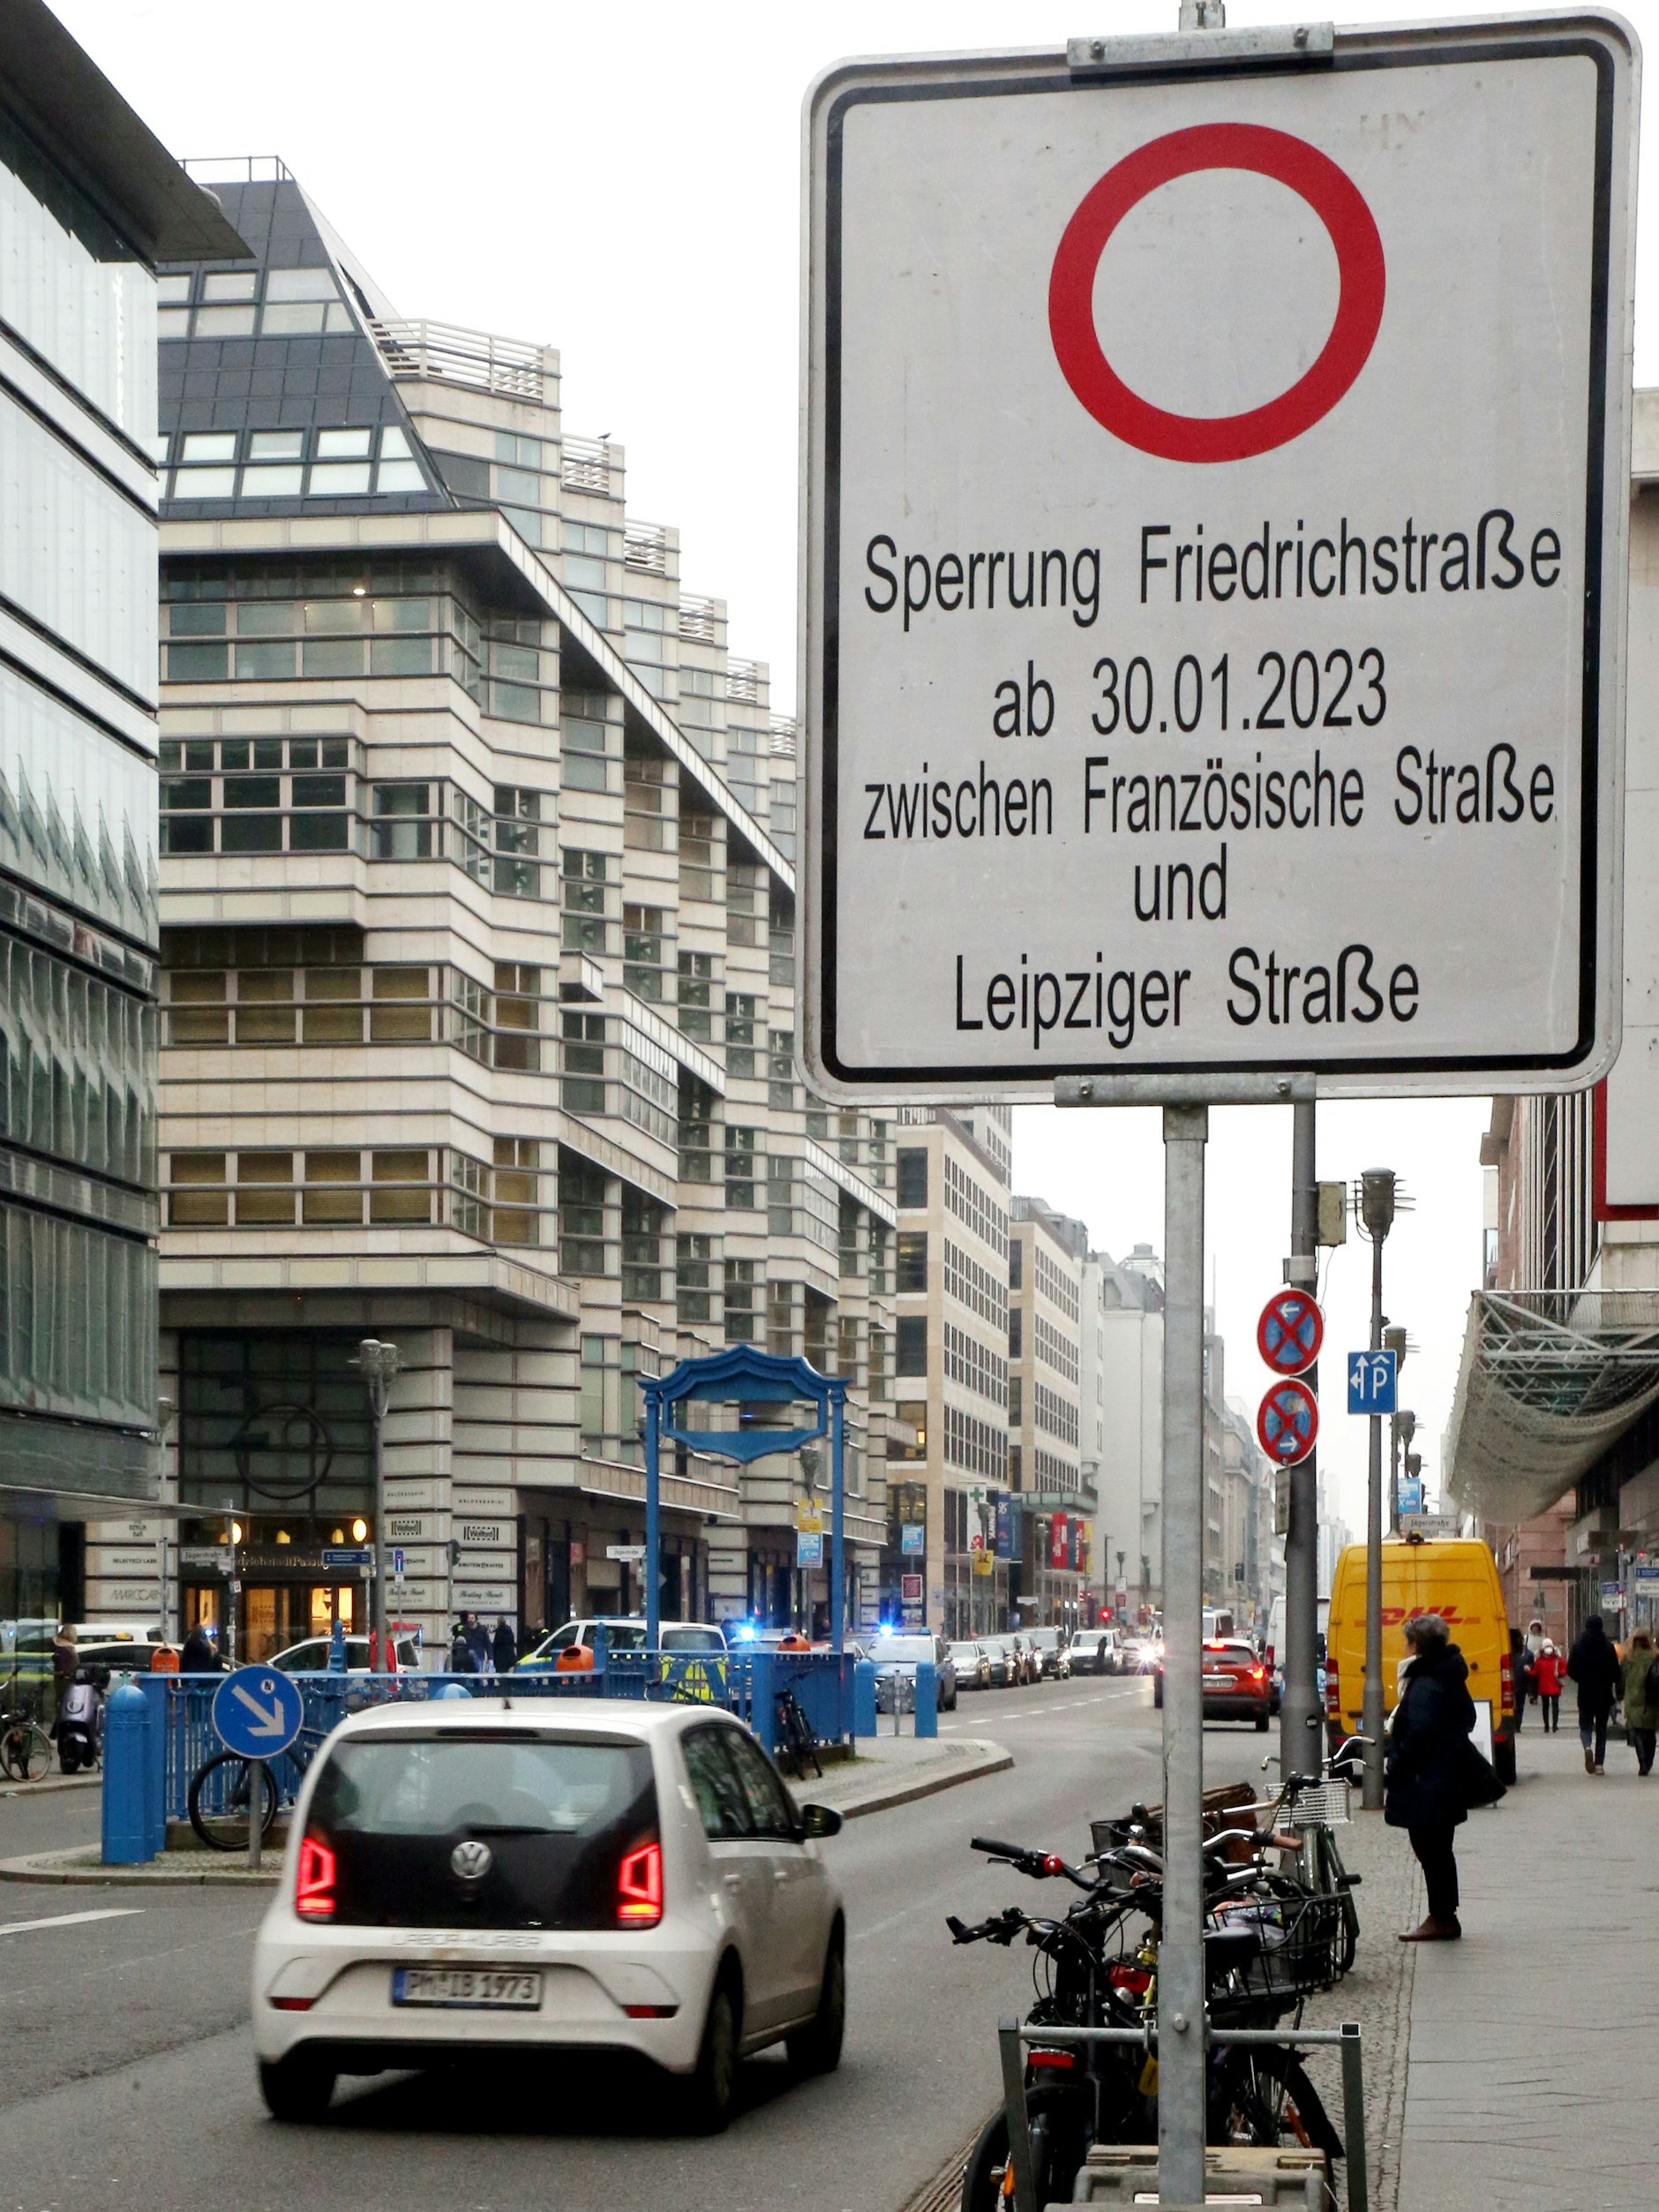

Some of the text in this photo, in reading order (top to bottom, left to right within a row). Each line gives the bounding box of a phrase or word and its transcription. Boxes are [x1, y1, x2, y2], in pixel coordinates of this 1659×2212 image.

[864, 508, 1562, 633] Sperrung Friedrichstraße
[993, 646, 1387, 739] ab 30.01.2023
[863, 741, 1555, 840] zwischen Französische Straße
[1134, 841, 1227, 922] und
[956, 944, 1419, 1050] Leipziger Straße
[1372, 1366, 1388, 1399] P
[481, 1975, 533, 1999] 1973
